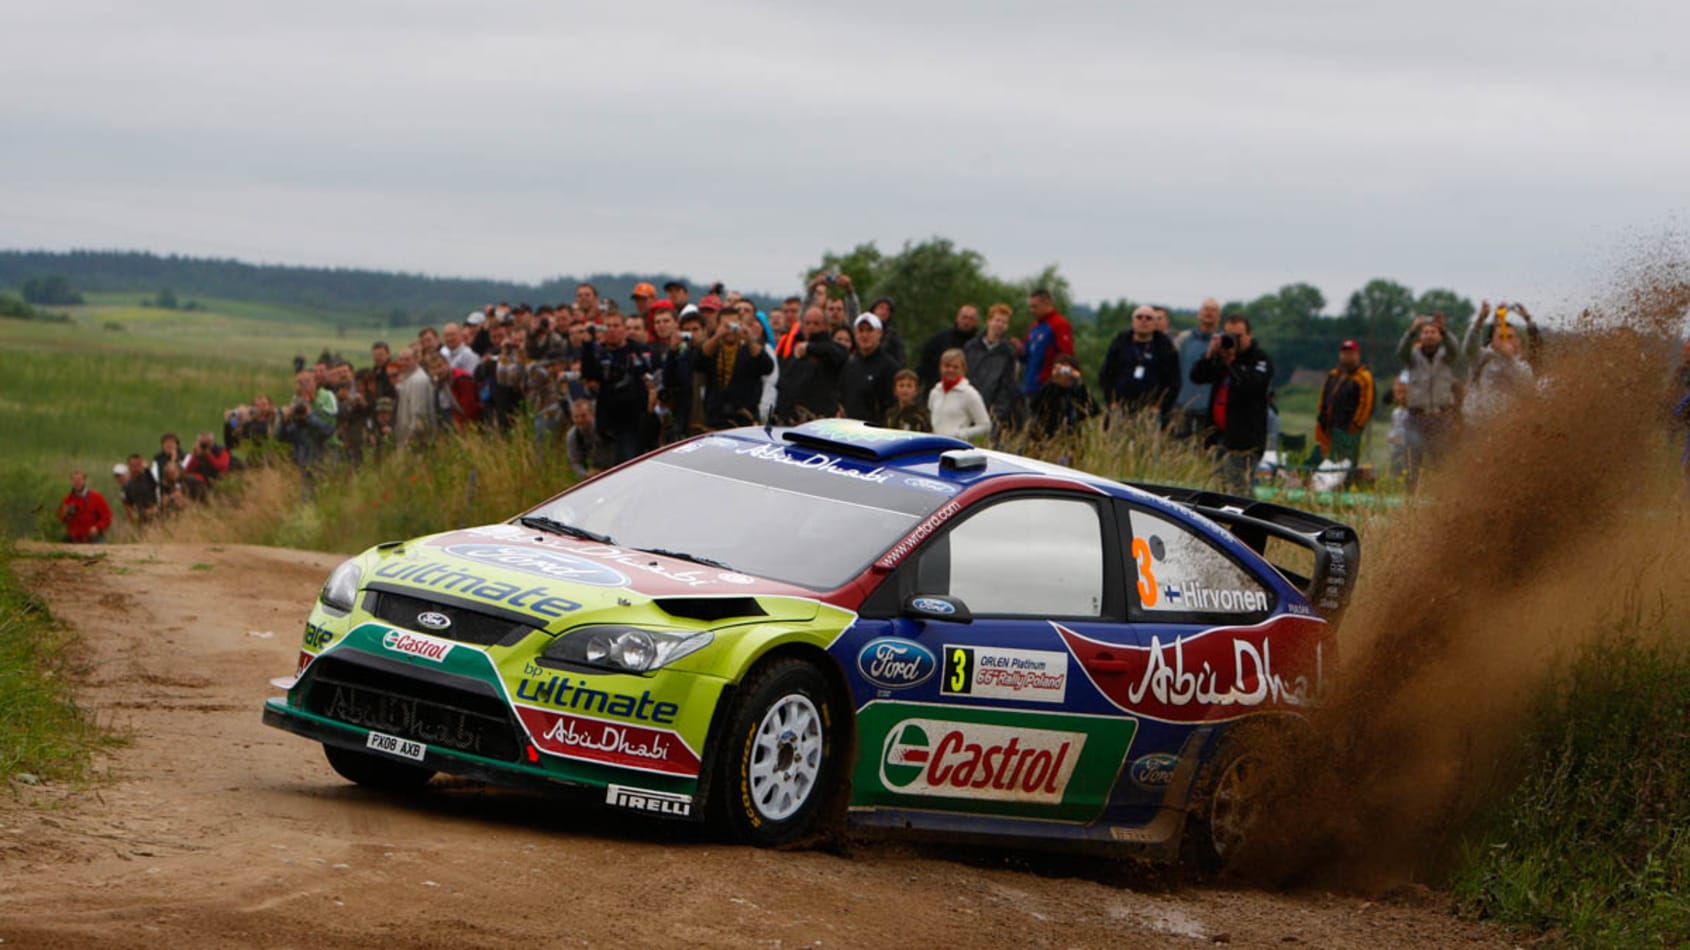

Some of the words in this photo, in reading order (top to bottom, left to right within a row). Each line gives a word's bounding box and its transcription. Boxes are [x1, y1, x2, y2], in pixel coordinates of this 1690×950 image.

[470, 548, 598, 577] Ford
[1131, 536, 1158, 607] 3
[375, 561, 582, 618] ultimate
[1182, 581, 1268, 611] Hirvonen
[396, 635, 447, 660] Castrol
[870, 643, 922, 680] Ford
[980, 655, 1010, 669] ORLEN
[1011, 659, 1046, 670] Platinum
[523, 662, 543, 678] bp
[951, 648, 966, 691] 3
[996, 670, 1025, 691] Rally
[1024, 671, 1064, 690] Poland
[516, 676, 679, 724] ultimate
[371, 734, 396, 751] PX08
[400, 743, 421, 757] AXB
[926, 730, 1070, 794] Castrol
[605, 783, 693, 816] PIRELLI
